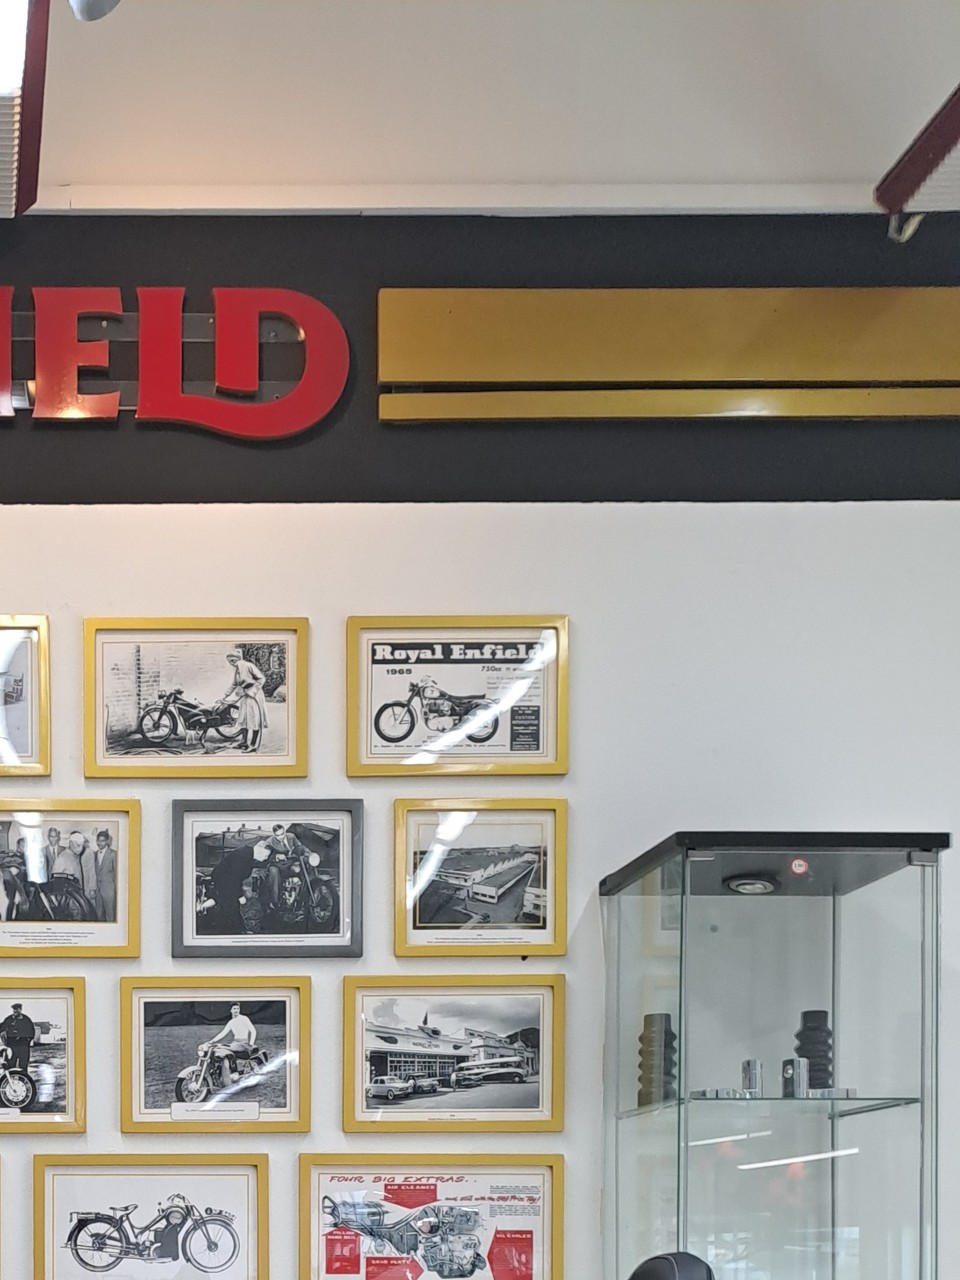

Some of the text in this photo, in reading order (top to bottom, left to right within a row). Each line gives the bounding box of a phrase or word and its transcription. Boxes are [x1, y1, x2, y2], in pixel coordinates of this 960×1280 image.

[373, 644, 444, 663] Royal
[329, 1175, 365, 1183] FOUR
[372, 1175, 395, 1183] BIG
